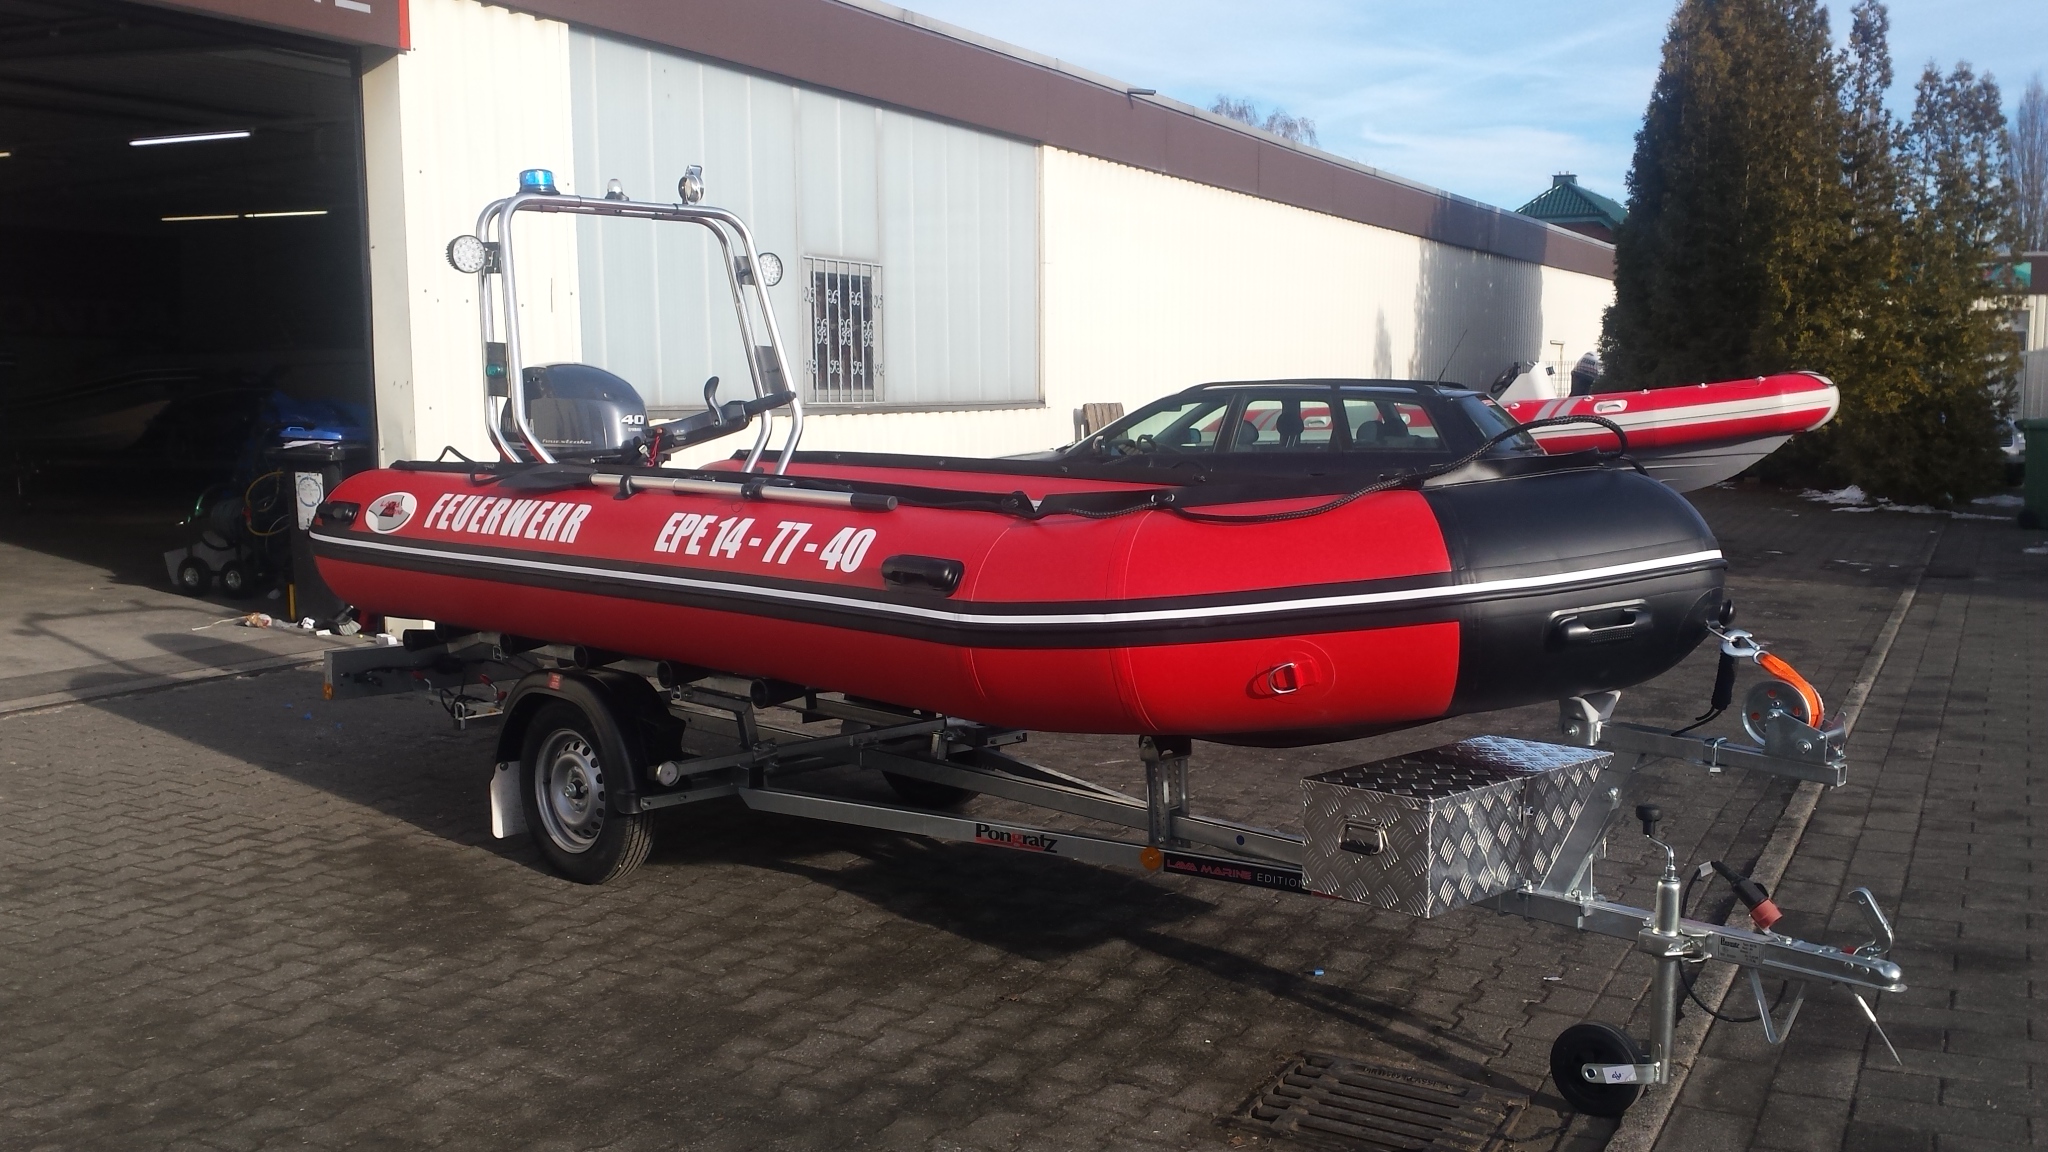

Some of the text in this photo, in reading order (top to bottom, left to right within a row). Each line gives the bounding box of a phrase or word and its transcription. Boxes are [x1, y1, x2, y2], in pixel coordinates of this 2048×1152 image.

[620, 414, 645, 425] 40
[424, 493, 592, 543] FEUERWEHR
[654, 512, 718, 555] EPE
[819, 527, 876, 573] 40
[975, 823, 1058, 853] Pongratz
[1166, 859, 1198, 872] LAVA
[1200, 864, 1252, 880] MARINE
